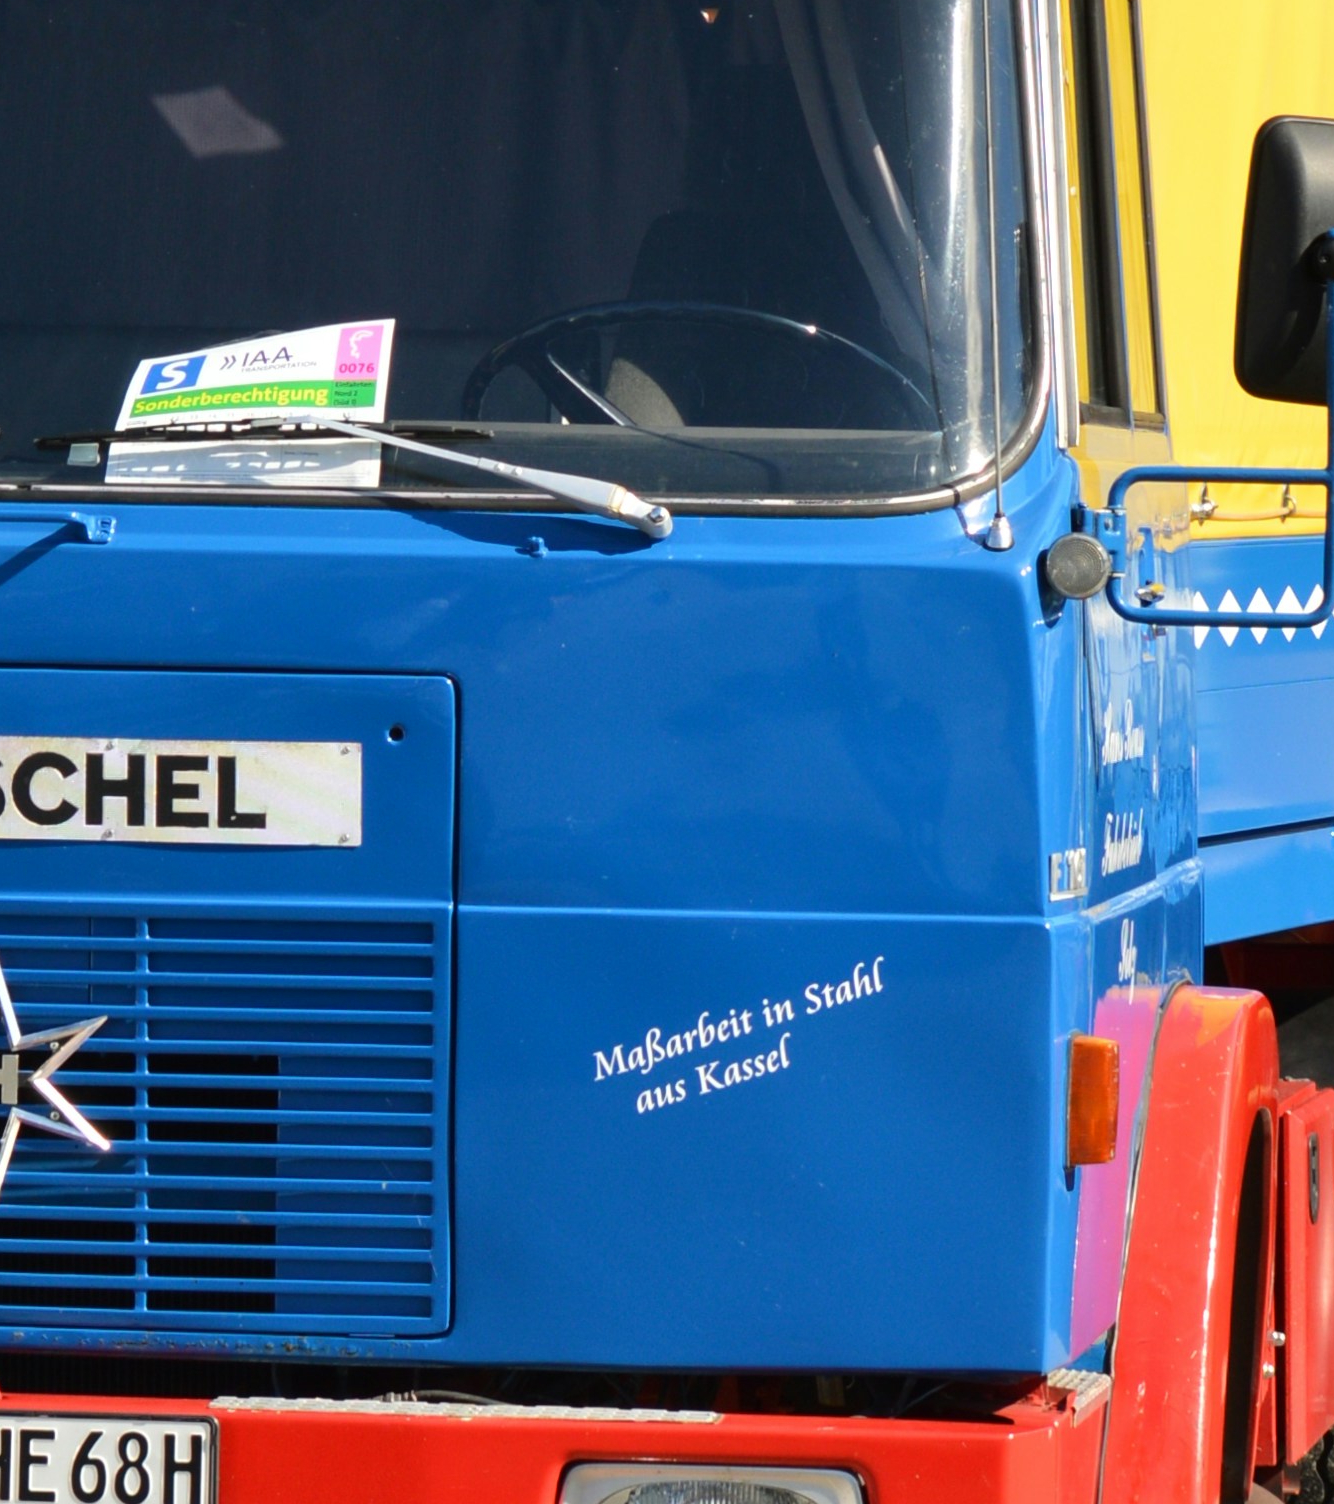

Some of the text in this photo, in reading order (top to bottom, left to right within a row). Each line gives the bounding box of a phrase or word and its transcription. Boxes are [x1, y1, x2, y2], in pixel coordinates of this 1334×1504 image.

[241, 360, 318, 373] TRANSPORTATION
[242, 346, 294, 368] IAA
[338, 362, 375, 374] 0076
[155, 358, 190, 391] S
[134, 386, 329, 414] Sonderberechtigung
[593, 956, 884, 1082] Maßarbeit in Stahl
[636, 1032, 791, 1115] aus Kassel
